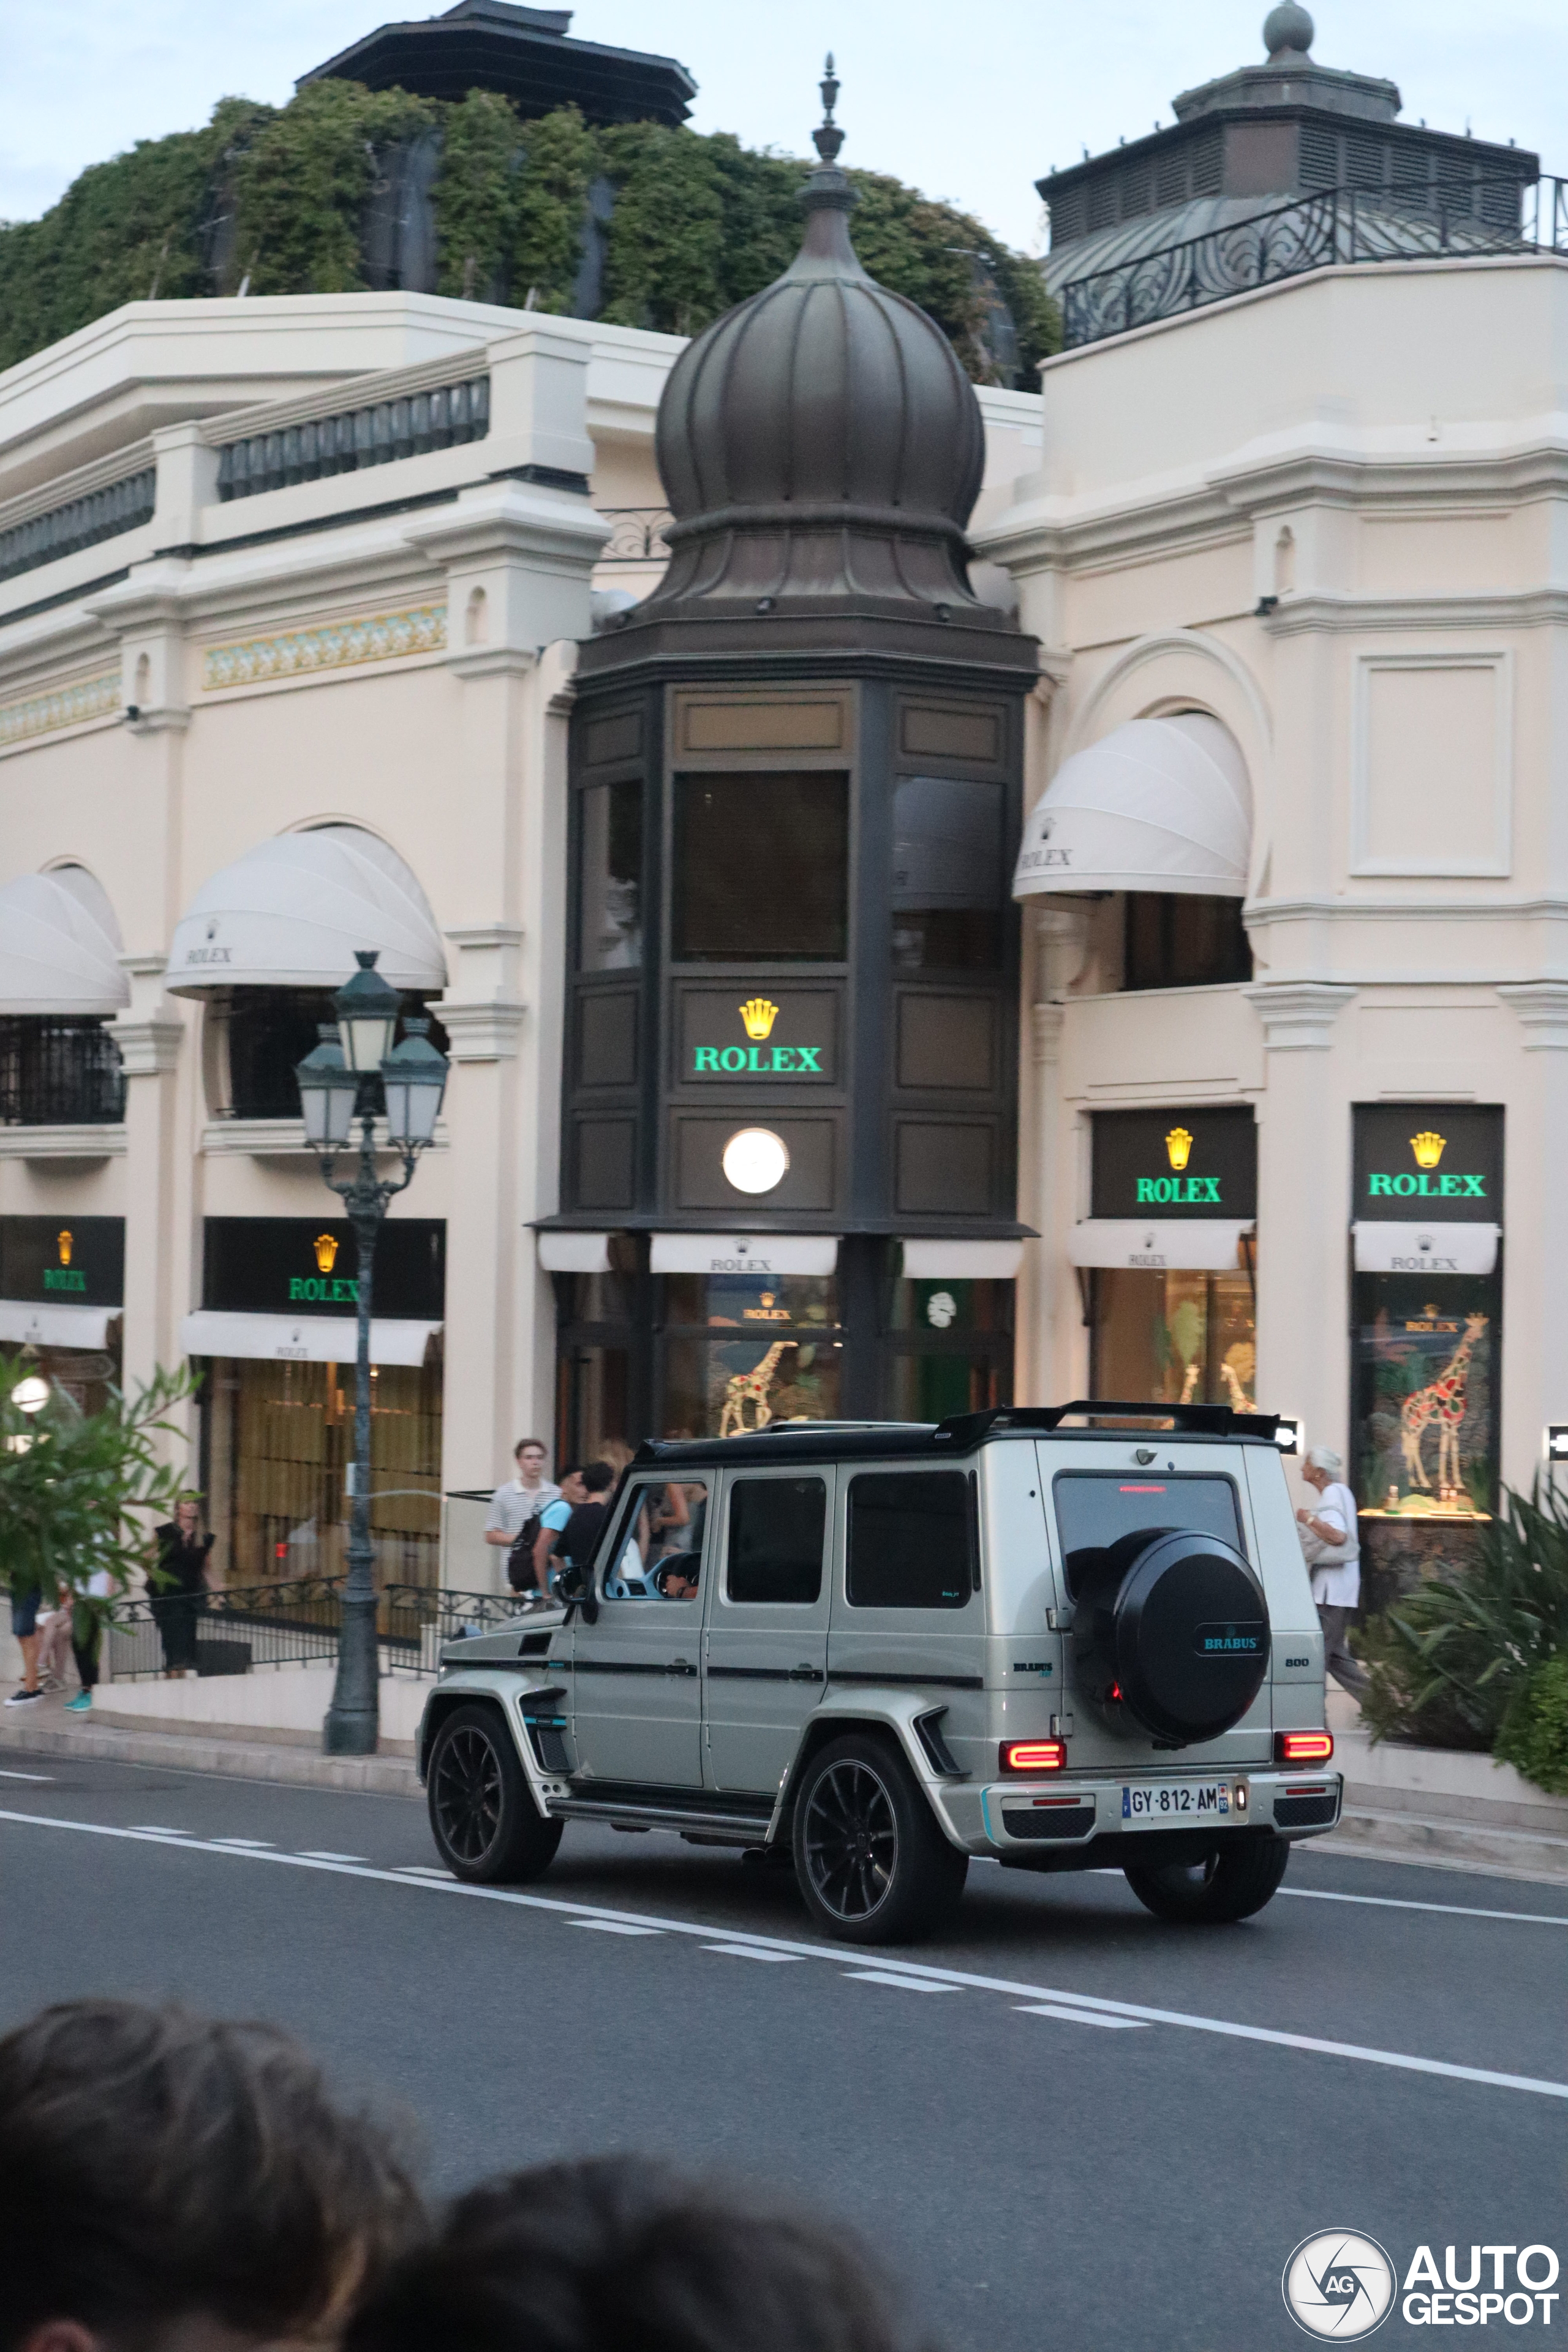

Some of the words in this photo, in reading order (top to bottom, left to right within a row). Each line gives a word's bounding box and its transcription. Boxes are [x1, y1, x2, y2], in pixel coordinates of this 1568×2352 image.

[693, 1046, 823, 1071] ROLEX
[1136, 1177, 1221, 1202] ROLEX
[1368, 1174, 1487, 1196] ROLEX
[710, 1259, 771, 1271] ROLEX
[1390, 1257, 1458, 1270] ROLEX
[744, 1309, 792, 1319] ROLEX
[1205, 1638, 1256, 1649] BRABUS
[1014, 1663, 1052, 1672] BRABUS
[1133, 1788, 1217, 1812] GY-812-AM
[1220, 1800, 1227, 1809] 92
